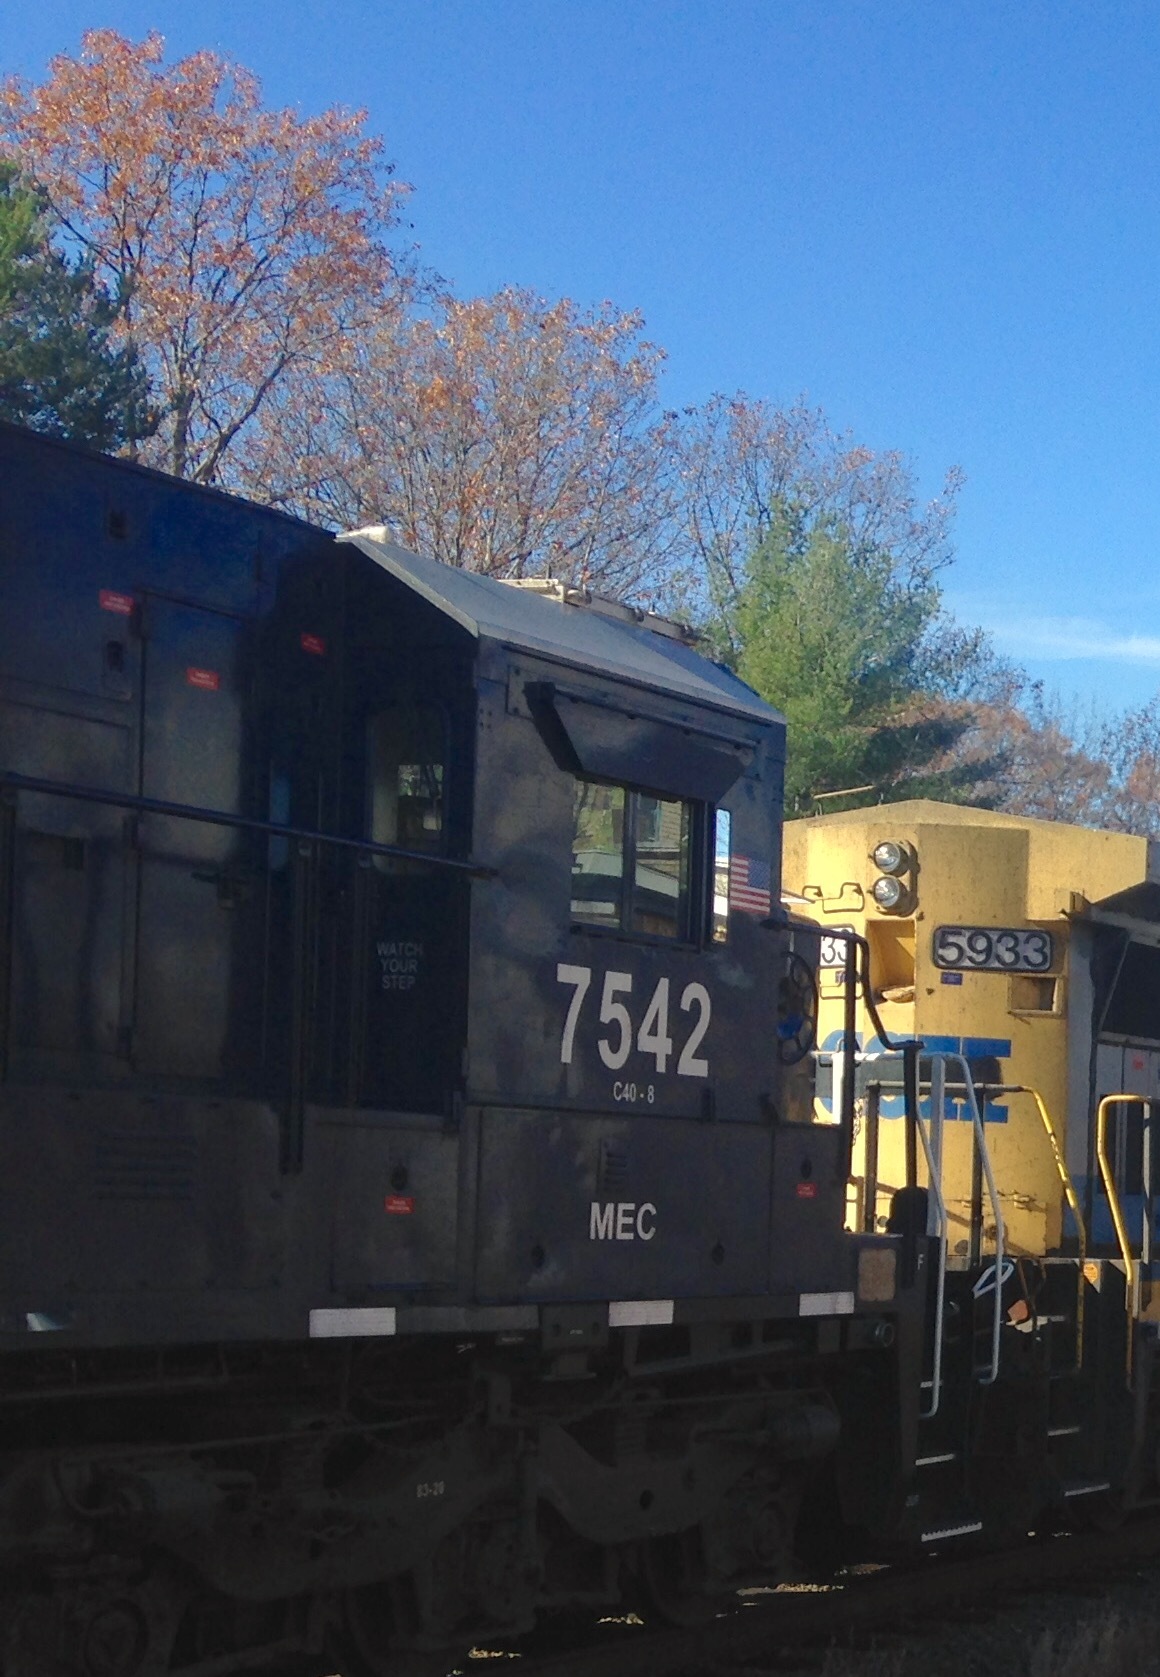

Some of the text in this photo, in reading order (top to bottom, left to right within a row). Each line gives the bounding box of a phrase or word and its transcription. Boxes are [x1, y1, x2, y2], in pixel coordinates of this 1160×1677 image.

[376, 941, 423, 957] WATCH
[937, 930, 1049, 968] 5933
[380, 958, 418, 973] YOUR
[382, 974, 416, 990] STEP
[556, 962, 712, 1078] 7542
[589, 1201, 657, 1241] MEC
